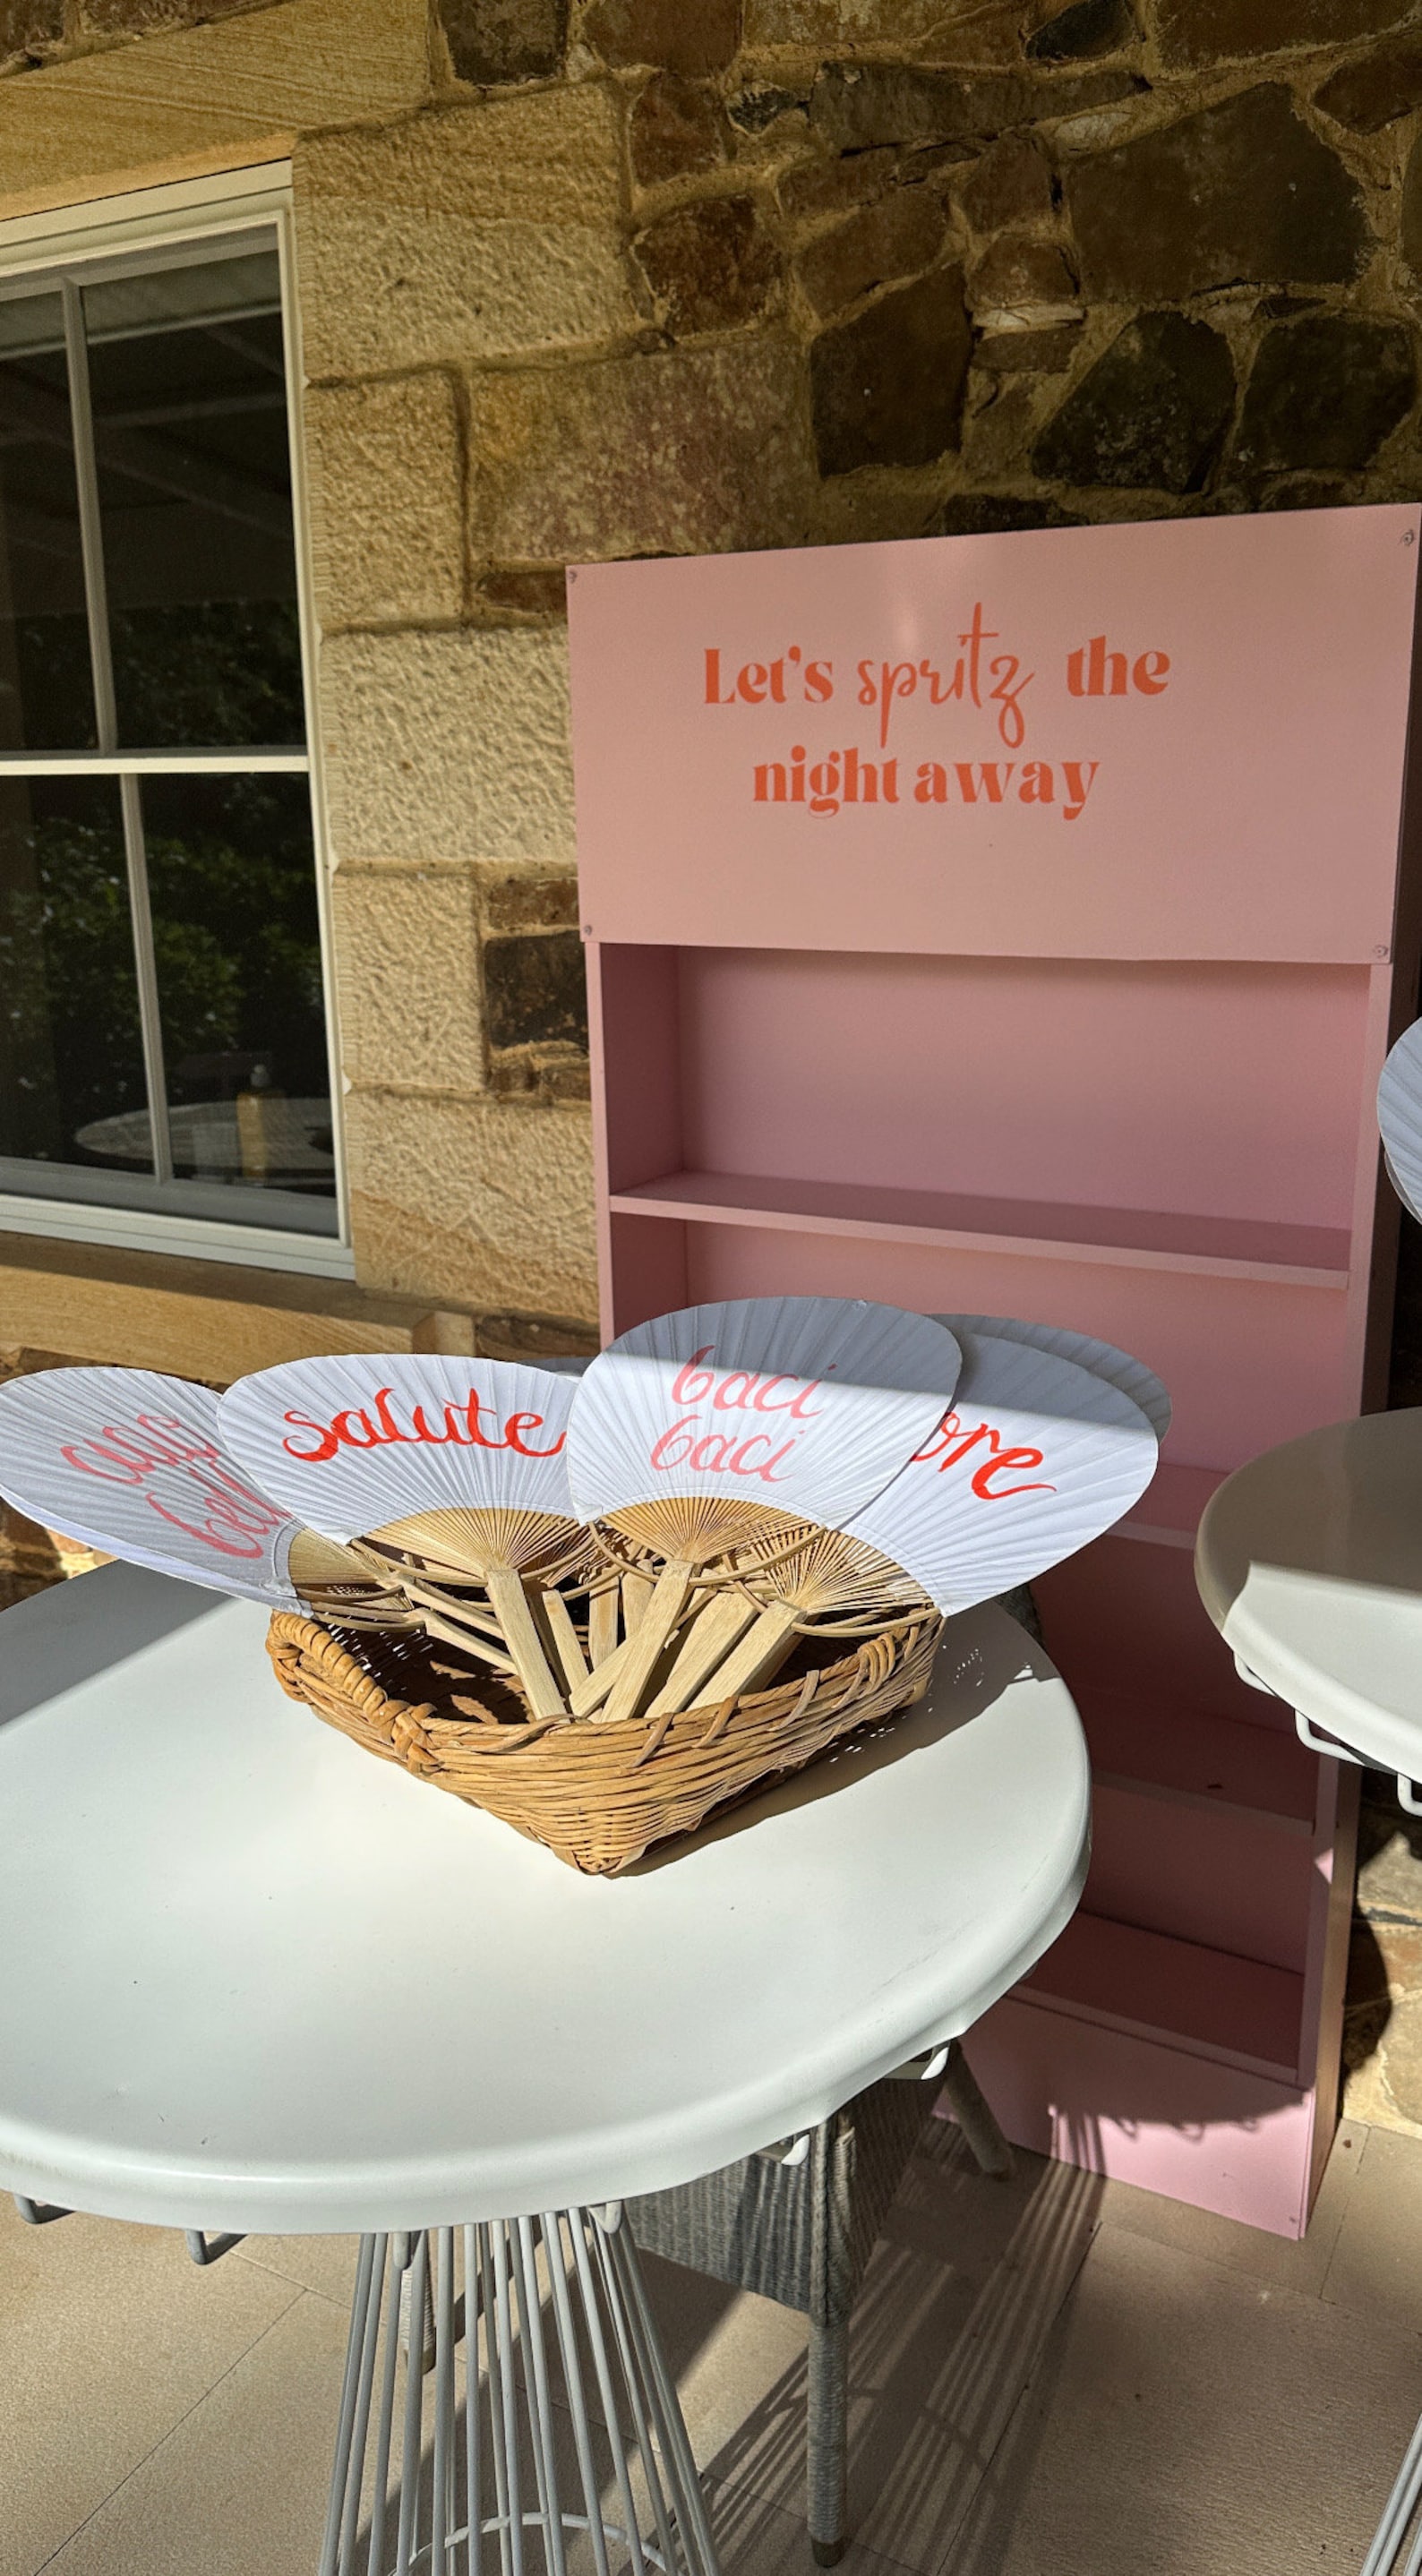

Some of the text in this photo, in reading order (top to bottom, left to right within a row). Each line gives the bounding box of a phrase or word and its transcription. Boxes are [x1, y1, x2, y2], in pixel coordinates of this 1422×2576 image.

[705, 602, 1170, 749] Let's spritz the
[752, 745, 1101, 821] night away
[672, 1344, 838, 1419] baci
[281, 1387, 568, 1463] salute
[650, 1414, 807, 1483] baci
[908, 1411, 1058, 1501] ore
[145, 1459, 294, 1560] bell
